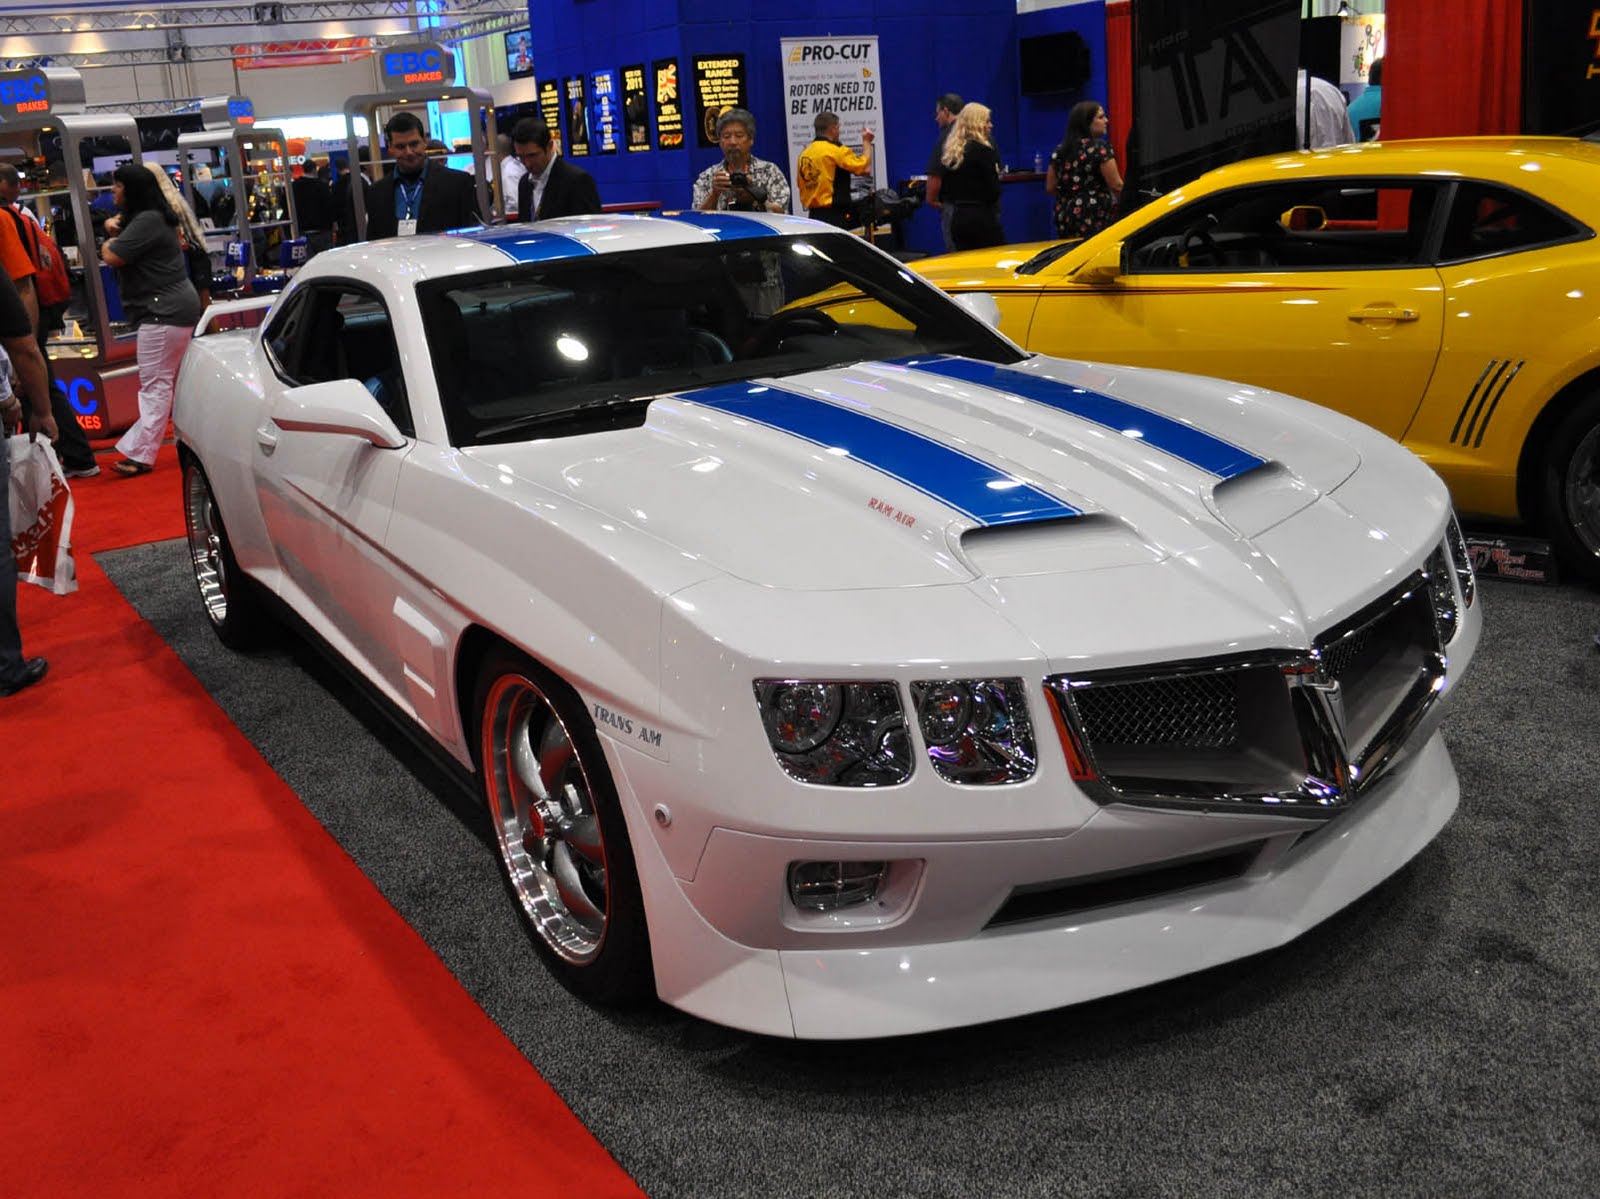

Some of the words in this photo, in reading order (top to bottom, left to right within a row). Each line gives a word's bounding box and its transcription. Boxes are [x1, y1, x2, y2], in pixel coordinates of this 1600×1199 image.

[801, 44, 871, 61] PRO-CUT
[384, 49, 441, 76] EBC
[697, 59, 739, 69] EXTENDED
[404, 70, 443, 85] BRAKES
[705, 69, 732, 78] RANGE
[0, 75, 46, 105] EBC
[626, 77, 643, 91] 2011
[789, 83, 830, 97] ROTORS
[833, 81, 860, 95] NEED
[863, 80, 876, 94] TO
[16, 100, 48, 113] BRAKES
[791, 99, 808, 115] BE
[812, 95, 877, 114] MATCHED.
[75, 415, 102, 430] KES
[868, 497, 894, 517] RAM
[894, 511, 916, 527] AIR
[593, 703, 634, 734] TRANS
[639, 727, 662, 747] AM
